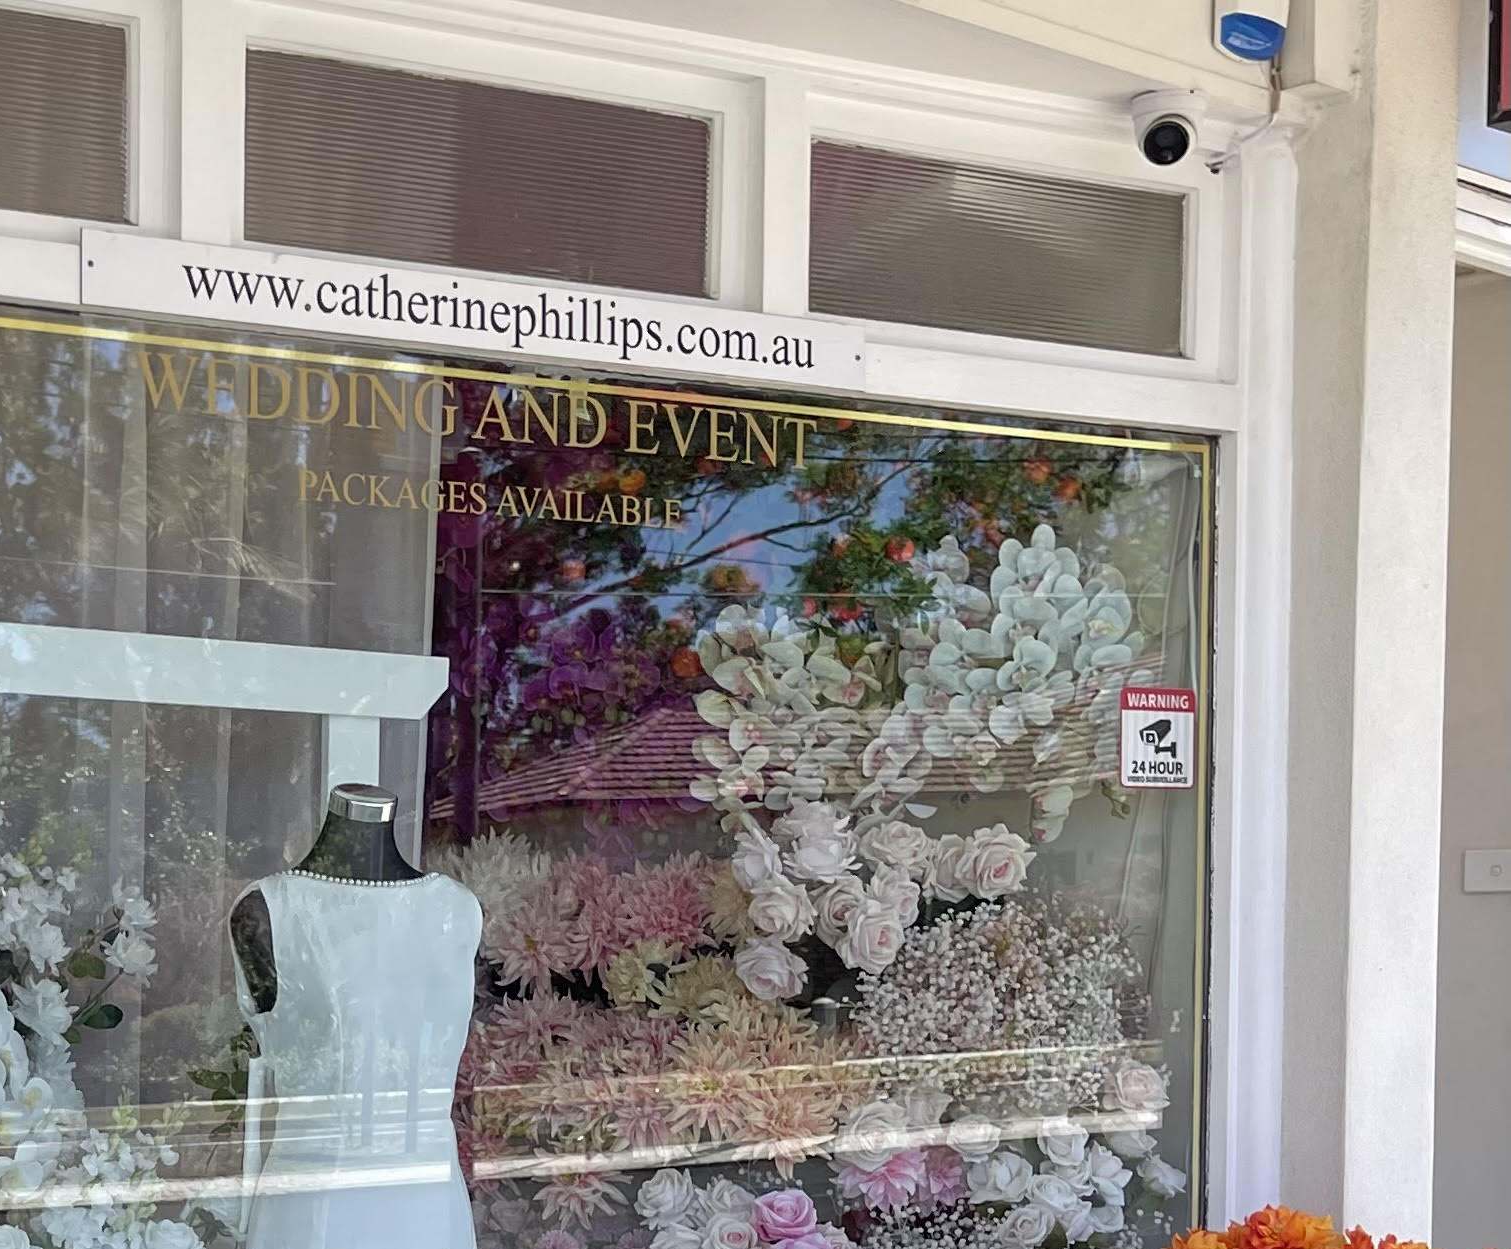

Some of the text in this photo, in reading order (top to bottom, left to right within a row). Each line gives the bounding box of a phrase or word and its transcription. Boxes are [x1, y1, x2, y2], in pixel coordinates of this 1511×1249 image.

[181, 262, 816, 371] www.catherinephillips.com.au
[137, 351, 818, 470] WEDDING AND EVENT
[299, 469, 683, 530] PACKAGES AVAILABLE
[1127, 693, 1190, 710] WARNING
[1131, 760, 1184, 776] 24 HOUR
